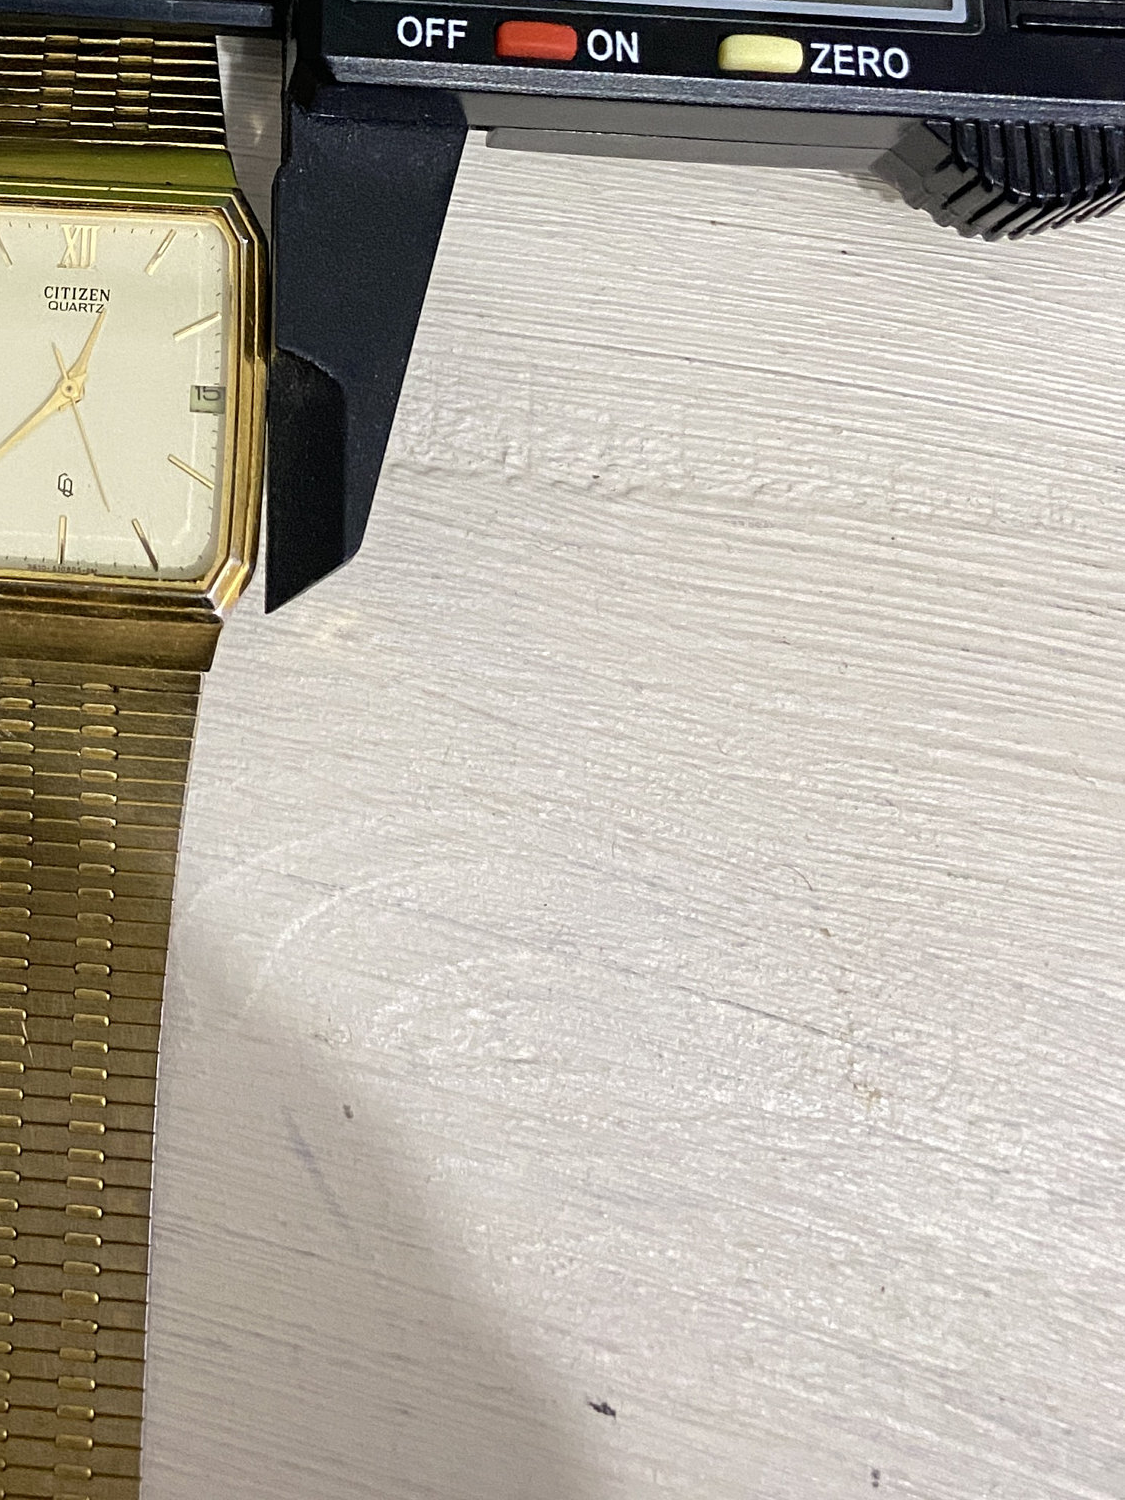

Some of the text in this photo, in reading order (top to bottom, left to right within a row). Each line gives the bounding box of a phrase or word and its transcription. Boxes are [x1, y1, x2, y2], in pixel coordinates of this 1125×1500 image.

[397, 16, 910, 79] OFF ON ZERO
[57, 223, 101, 269] XII
[44, 285, 111, 302] CITIZEN
[48, 300, 105, 314] QUARTZ
[194, 385, 222, 402] 15
